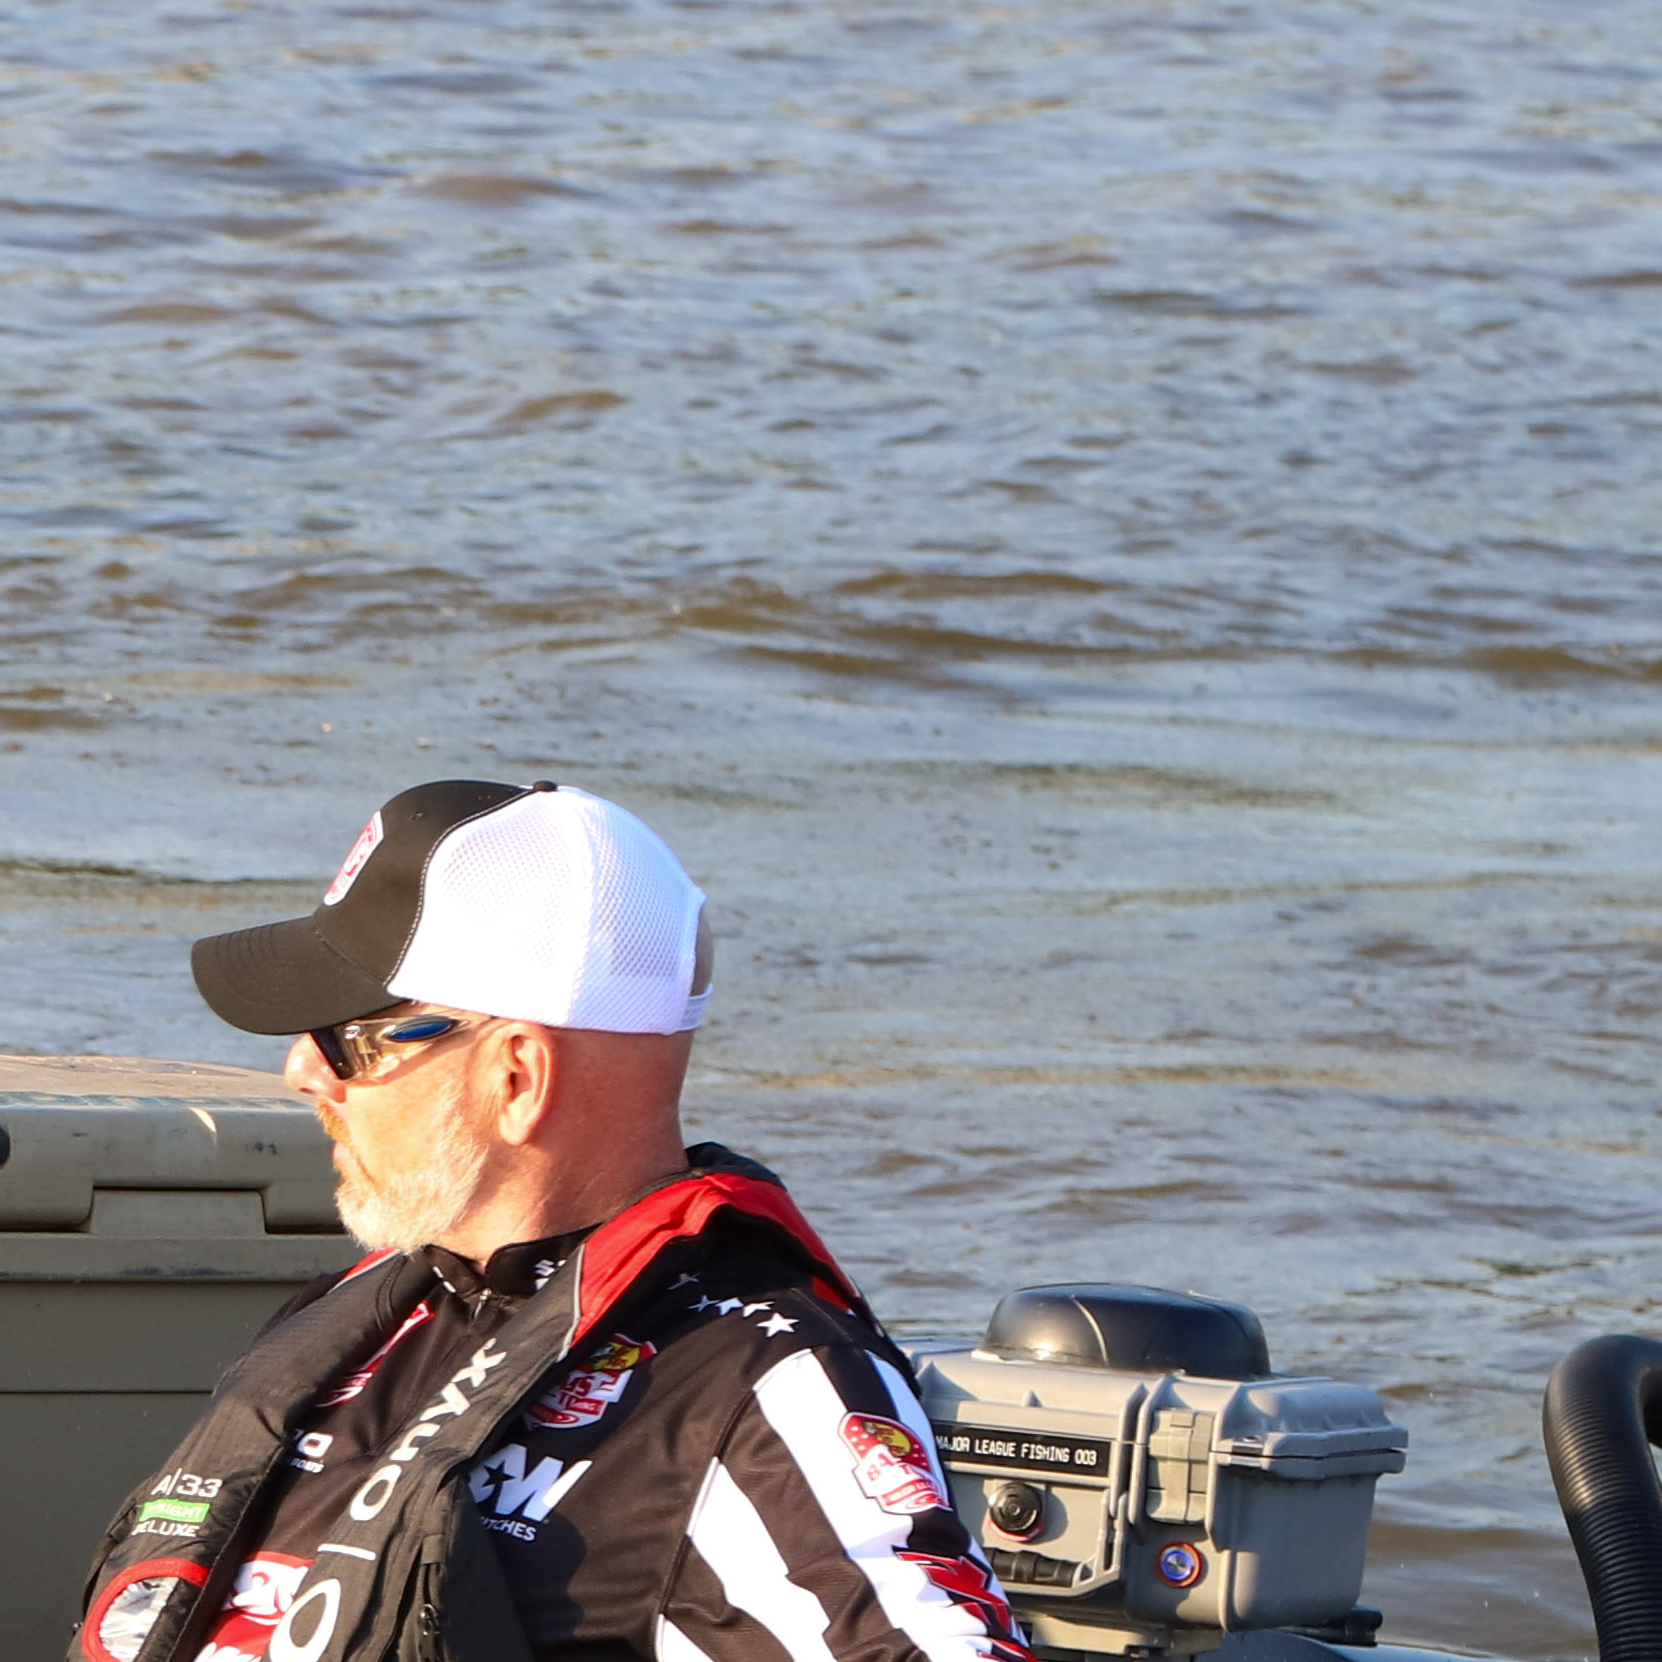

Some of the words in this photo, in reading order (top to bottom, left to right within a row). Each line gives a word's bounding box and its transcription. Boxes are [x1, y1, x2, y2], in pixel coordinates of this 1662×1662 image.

[935, 1435, 971, 1453] MAJOR
[975, 1438, 1017, 1458] LEAGUE
[1021, 1443, 1070, 1463] FISHING
[1074, 1448, 1098, 1466] 003
[480, 1516, 537, 1542] ITCHES
